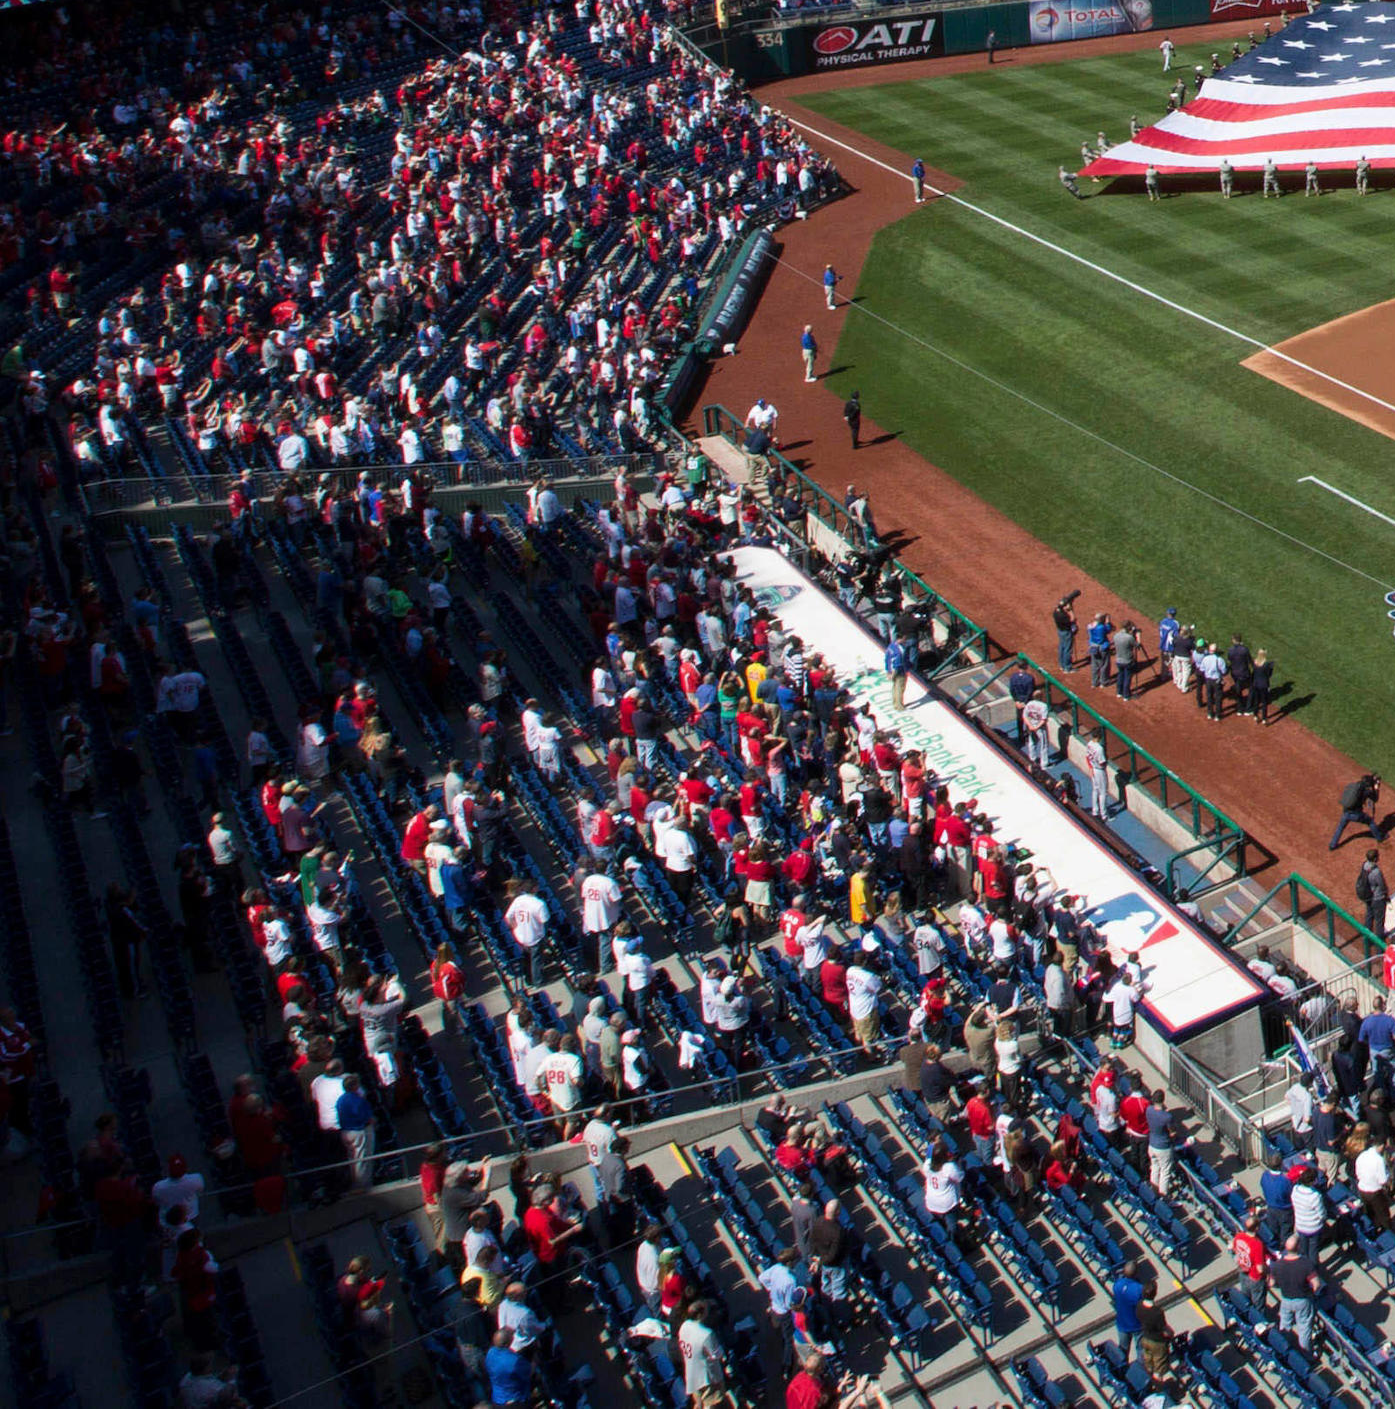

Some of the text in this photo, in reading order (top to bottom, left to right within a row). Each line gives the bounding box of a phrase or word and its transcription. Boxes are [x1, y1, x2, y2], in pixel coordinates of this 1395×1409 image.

[1064, 6, 1121, 23] TOTAL
[756, 33, 783, 47] 334
[856, 19, 936, 50] ATI
[817, 44, 931, 67] PHYSICAL THERAPY
[915, 733, 966, 770] Bank
[953, 764, 997, 798] Park
[587, 888, 600, 901] 26
[518, 909, 531, 924] 51
[783, 913, 798, 924] DAD
[785, 923, 791, 937] 1
[917, 939, 930, 950] 34
[547, 1070, 565, 1084] 28
